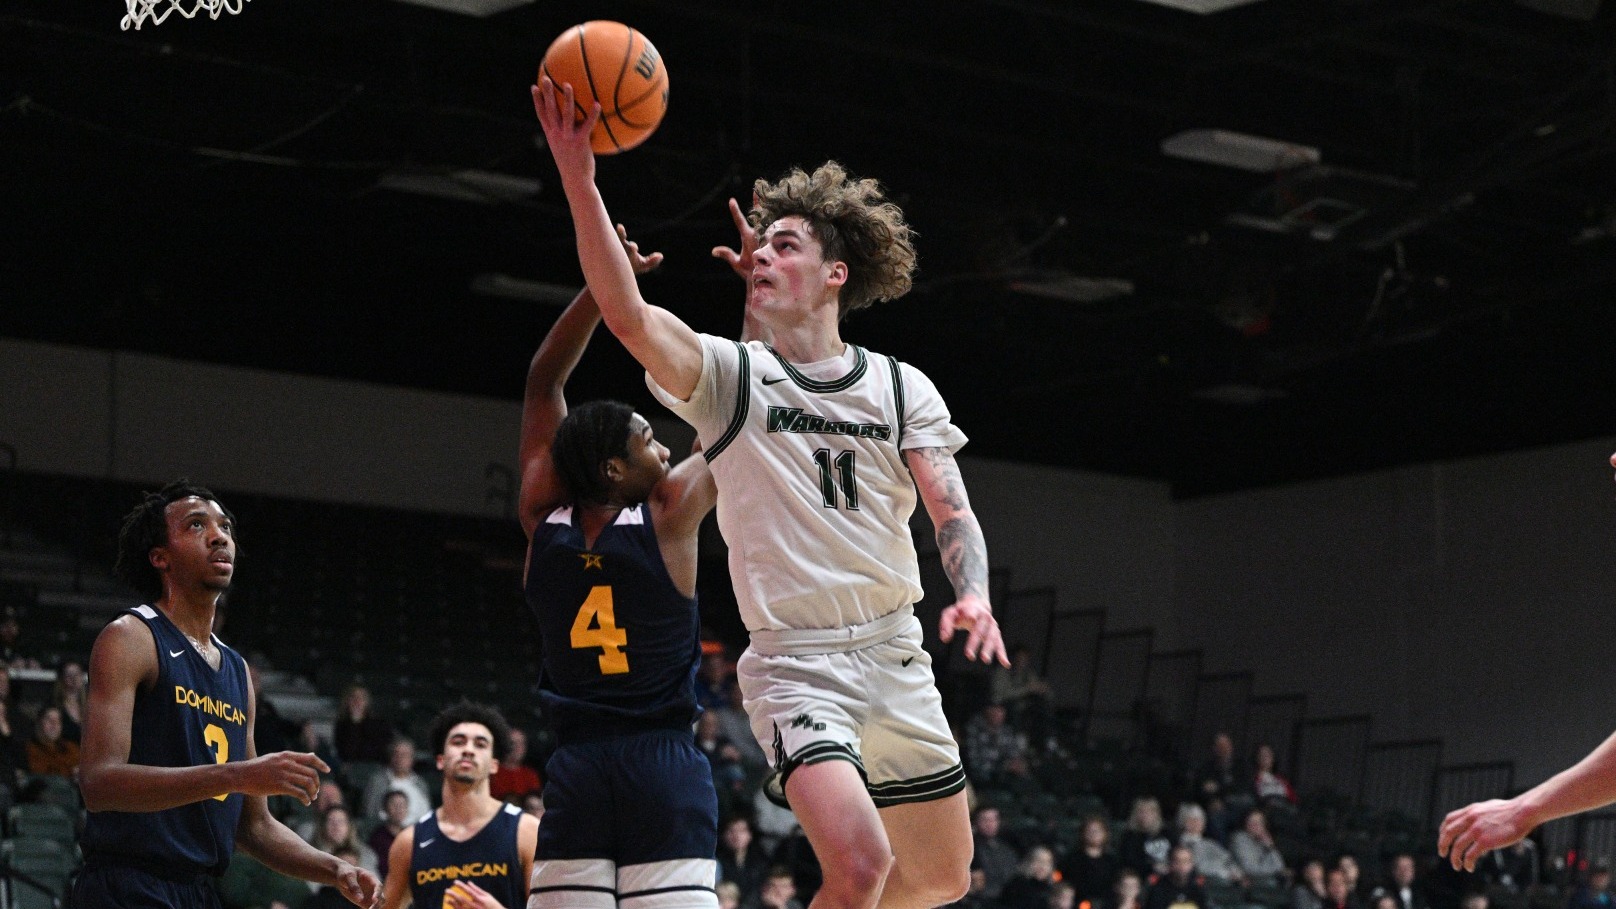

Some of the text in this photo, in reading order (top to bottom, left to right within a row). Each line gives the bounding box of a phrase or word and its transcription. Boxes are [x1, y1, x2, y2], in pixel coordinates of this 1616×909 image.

[812, 448, 860, 511] 11
[570, 585, 630, 675] 4
[175, 685, 246, 726] DOMINICAN
[416, 862, 508, 886] DOMINICAN
